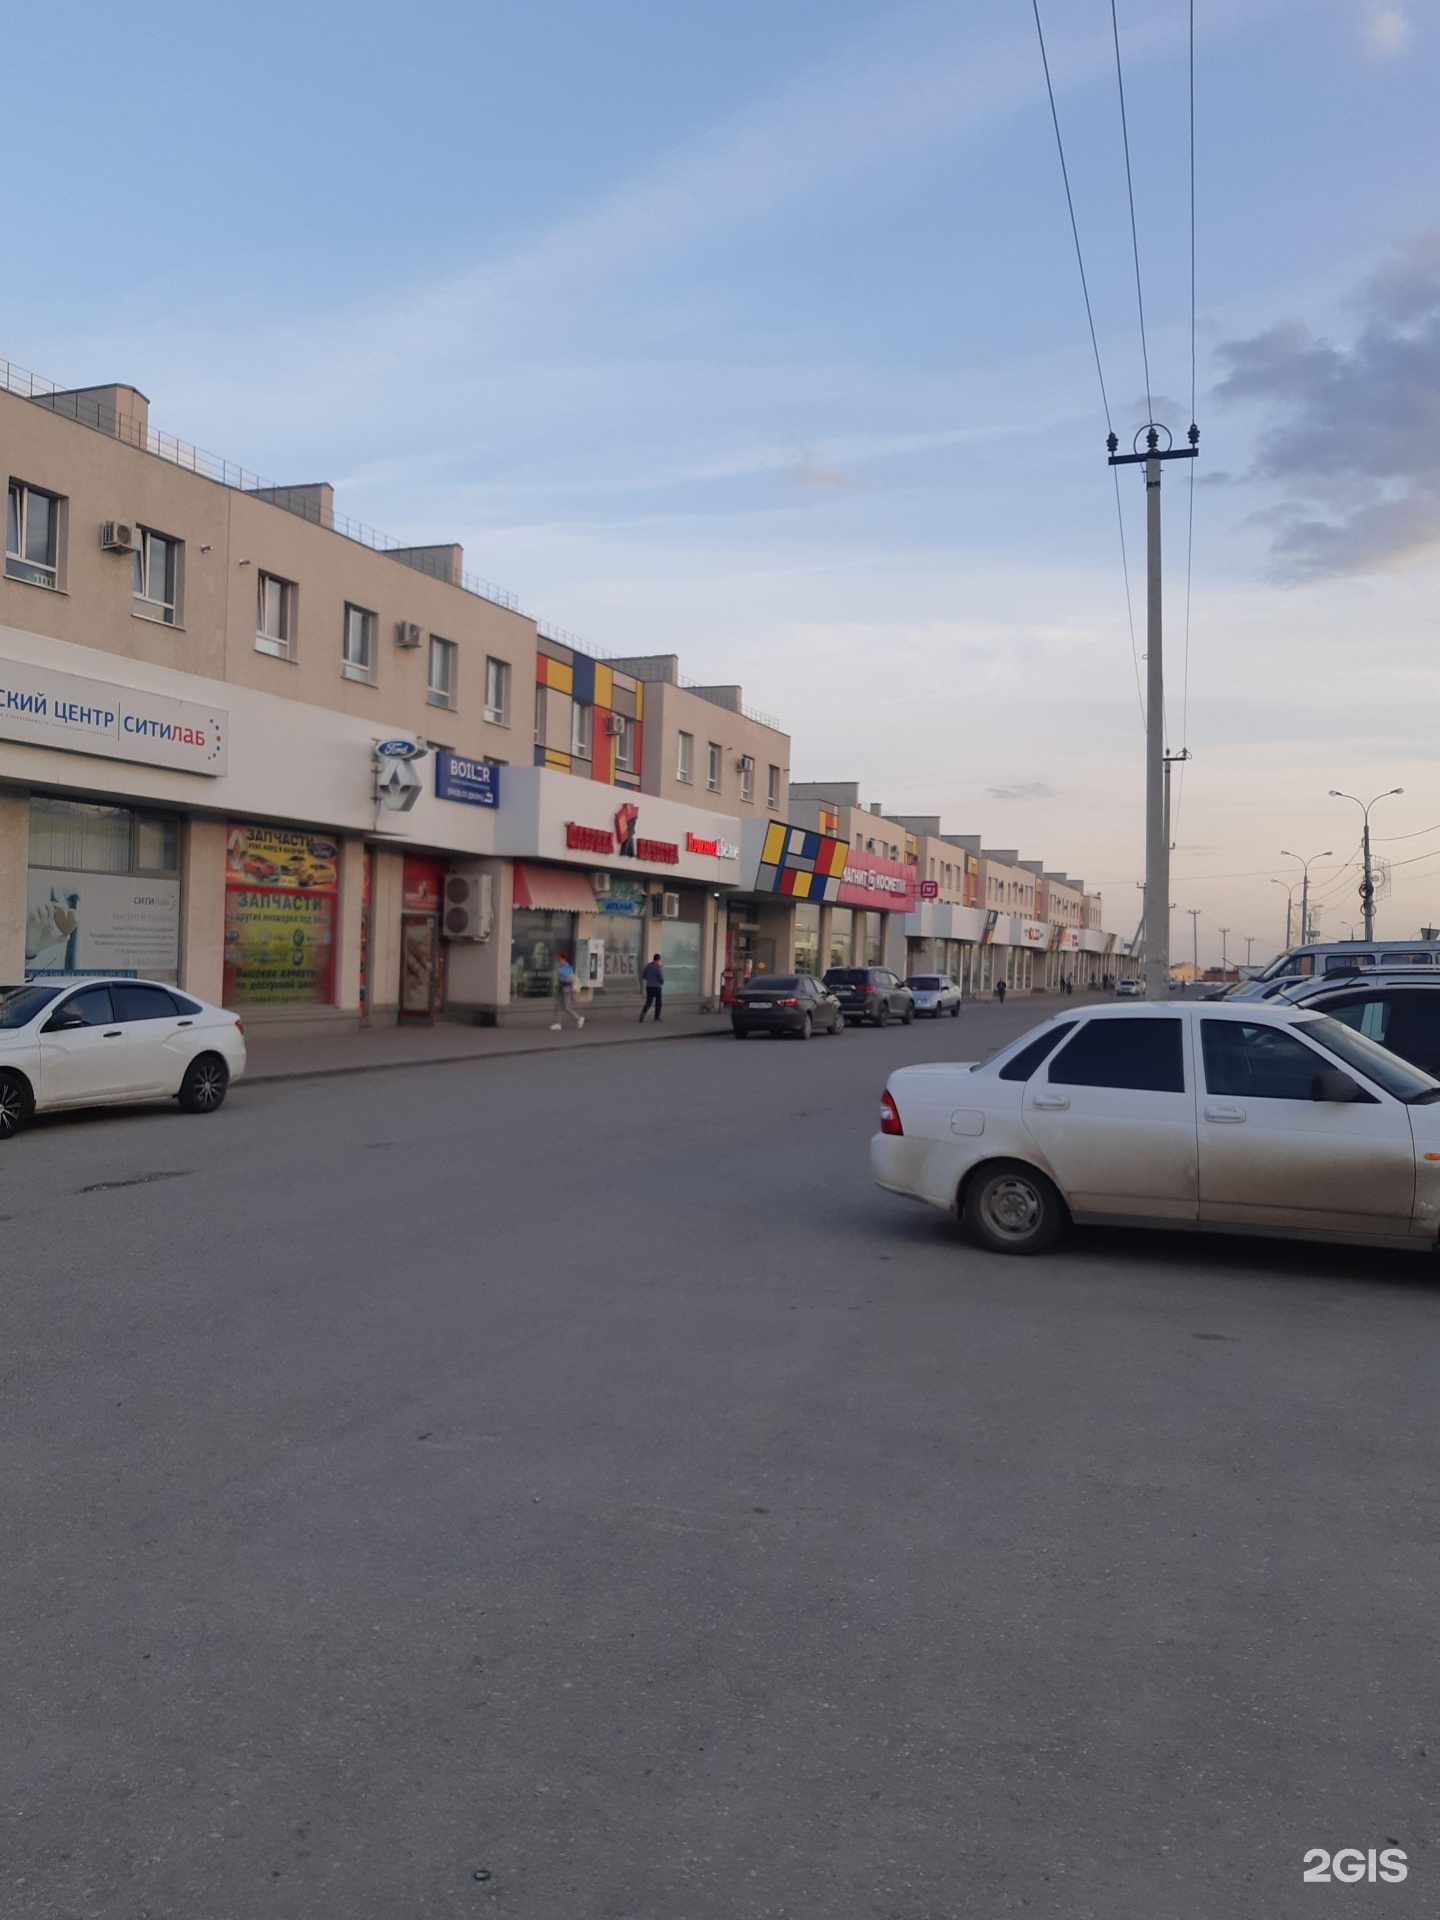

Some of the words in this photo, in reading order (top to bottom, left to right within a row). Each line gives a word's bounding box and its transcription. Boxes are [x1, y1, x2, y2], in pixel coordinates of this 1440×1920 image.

[54, 700, 115, 727] ЦЕНТР
[385, 743, 408, 756] Ford
[450, 759, 490, 783] BOILER
[246, 828, 314, 847] ЗАПЧАСТИ
[238, 893, 322, 911] ЗАПЧАСТИ
